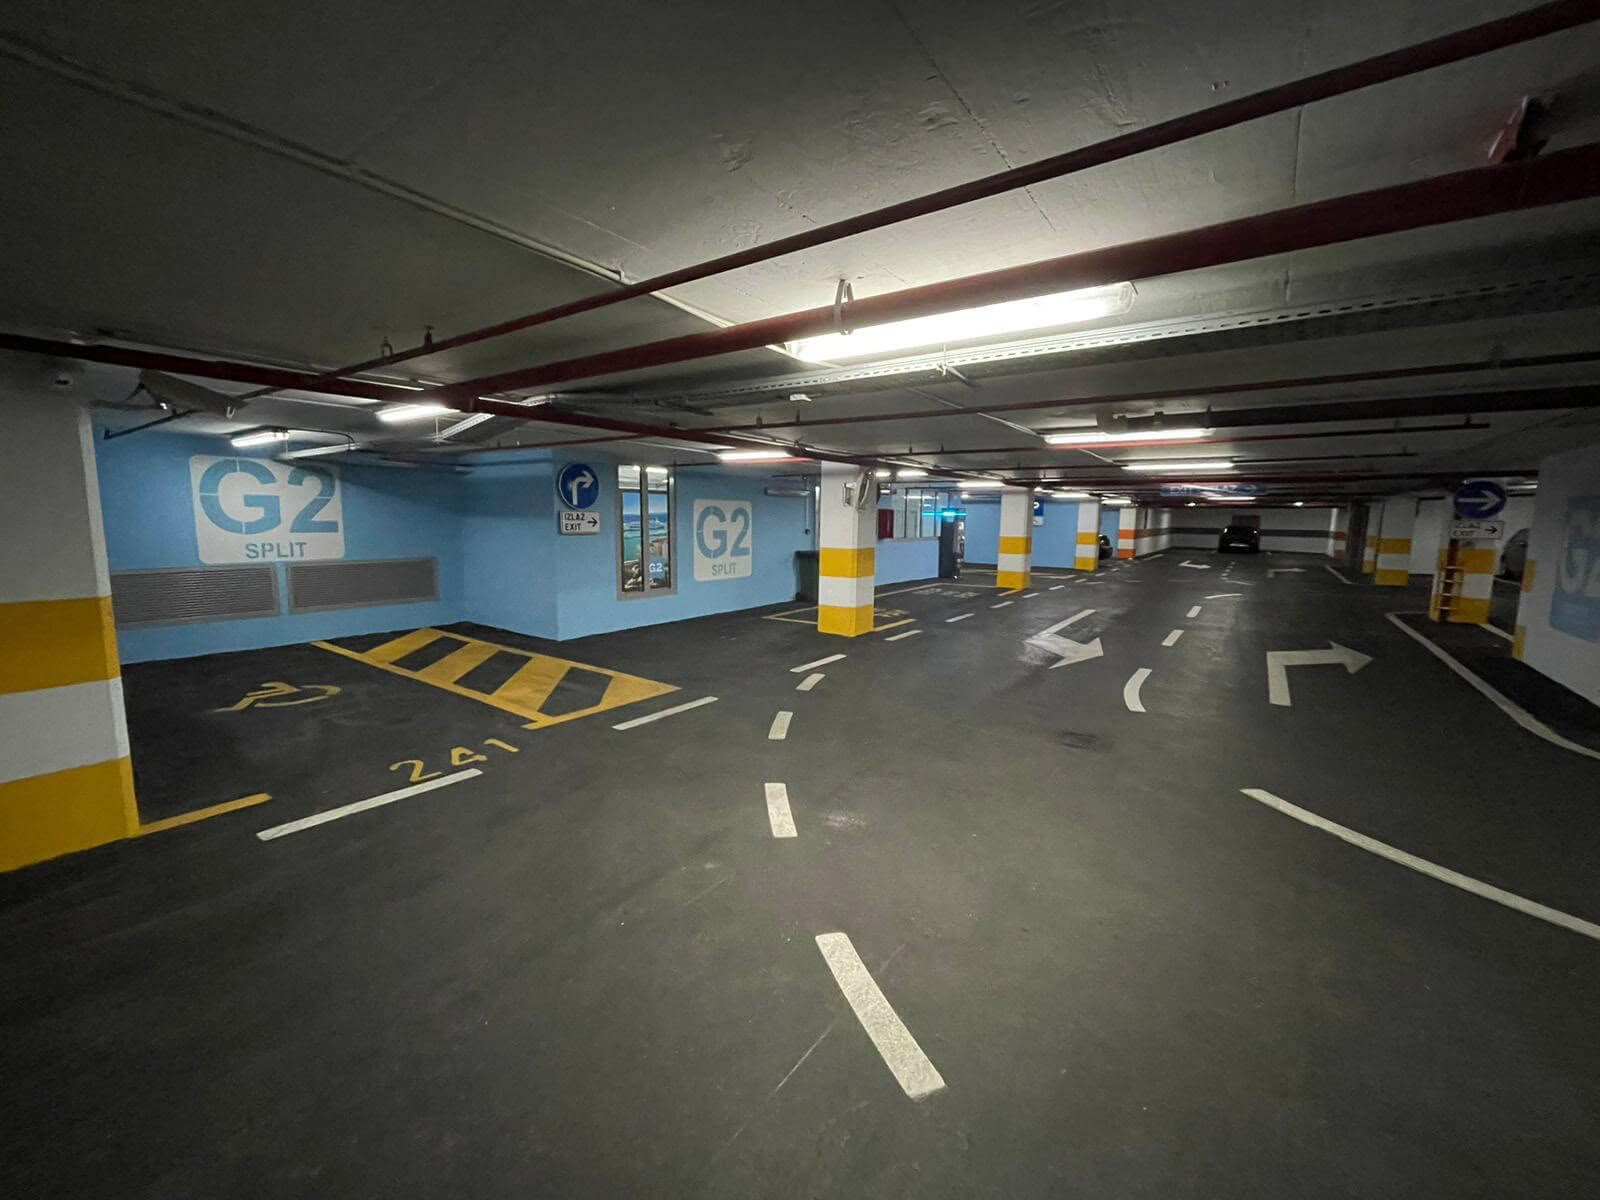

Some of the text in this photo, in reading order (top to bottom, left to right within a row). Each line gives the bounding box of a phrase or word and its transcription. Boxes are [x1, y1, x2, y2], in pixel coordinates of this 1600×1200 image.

[199, 458, 339, 534] G2
[564, 513, 586, 521] IZLAZ
[564, 523, 582, 531] EXIT
[696, 506, 750, 559] G2
[245, 542, 307, 559] SPLIT
[649, 562, 663, 573] G2
[712, 563, 736, 576] SPLIT
[389, 738, 519, 782] 241
